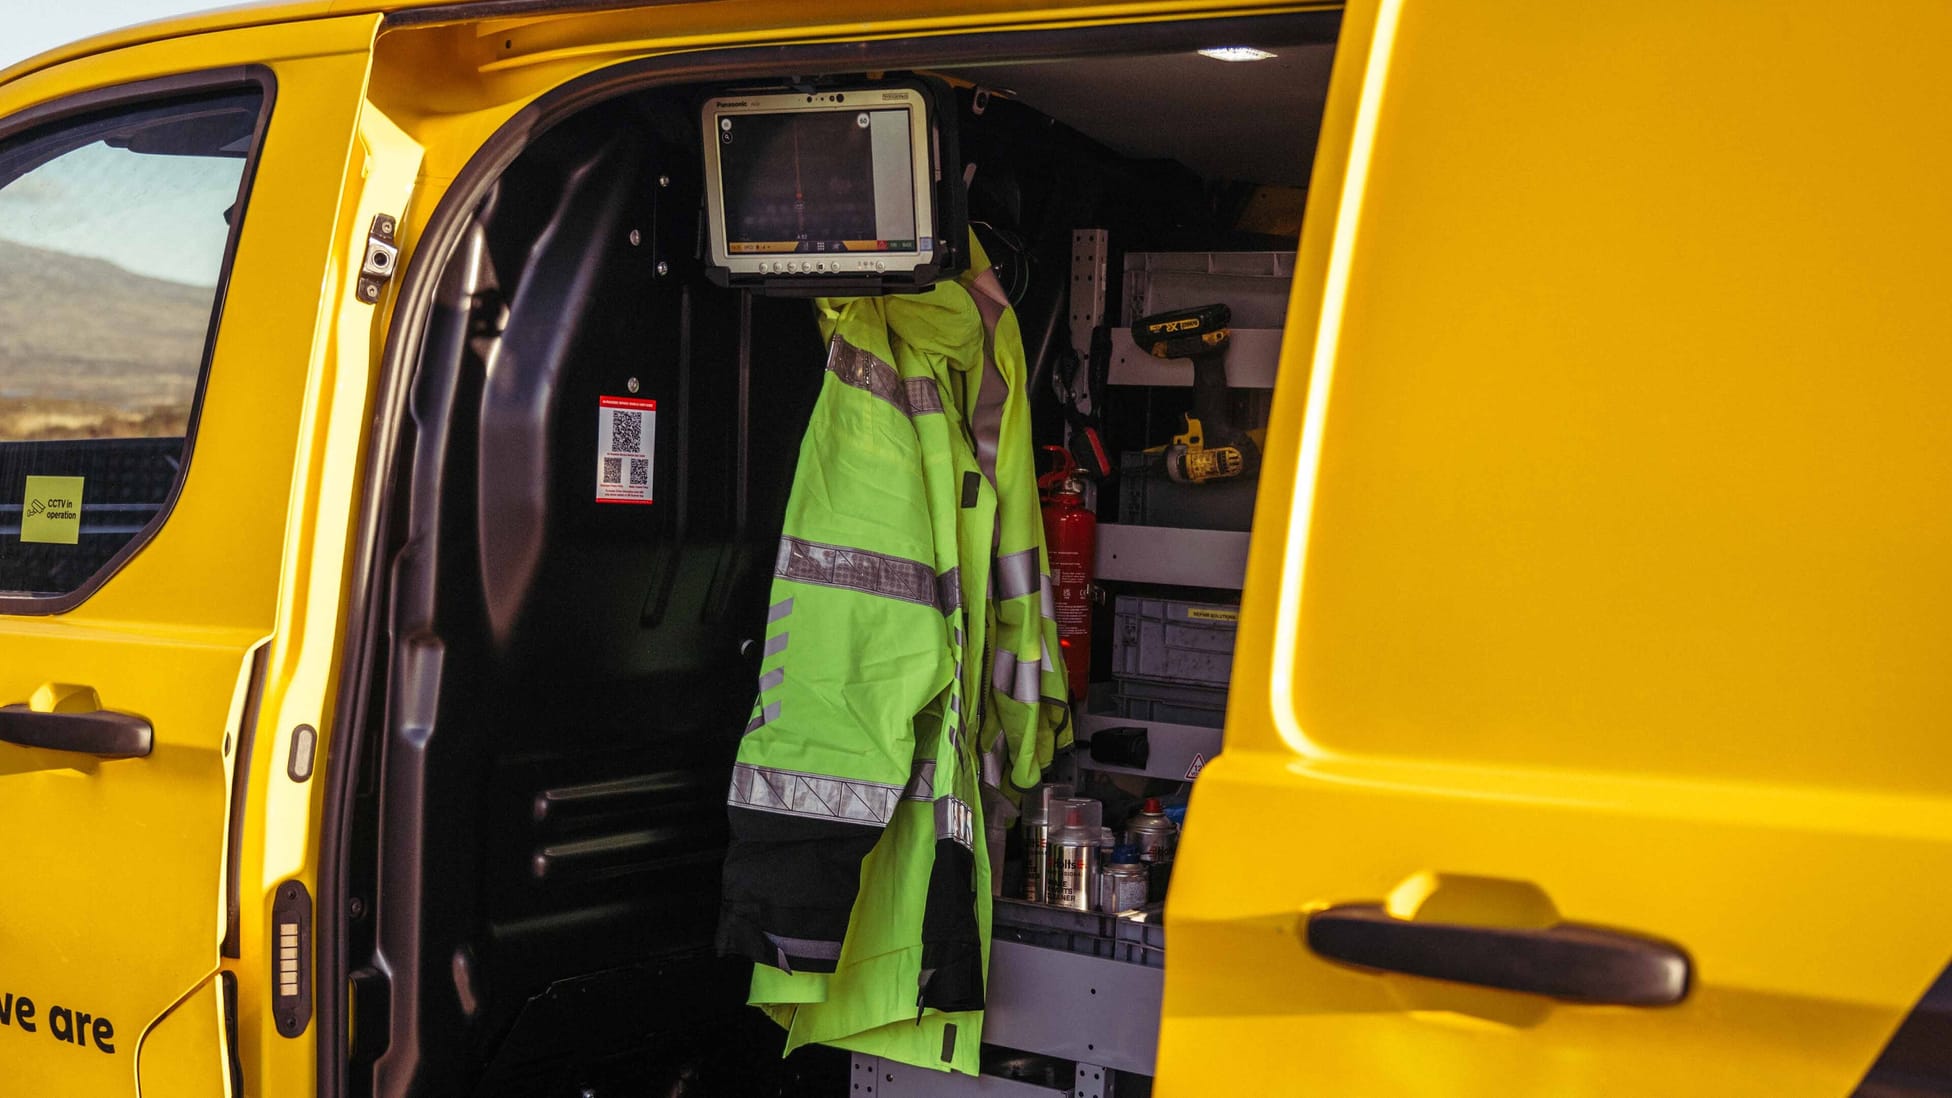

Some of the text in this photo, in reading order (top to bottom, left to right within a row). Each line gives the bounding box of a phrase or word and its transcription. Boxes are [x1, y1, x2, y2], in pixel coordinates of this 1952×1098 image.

[48, 499, 72, 508] CCTV in
[47, 510, 76, 519] operation
[49, 1005, 116, 1054] are
